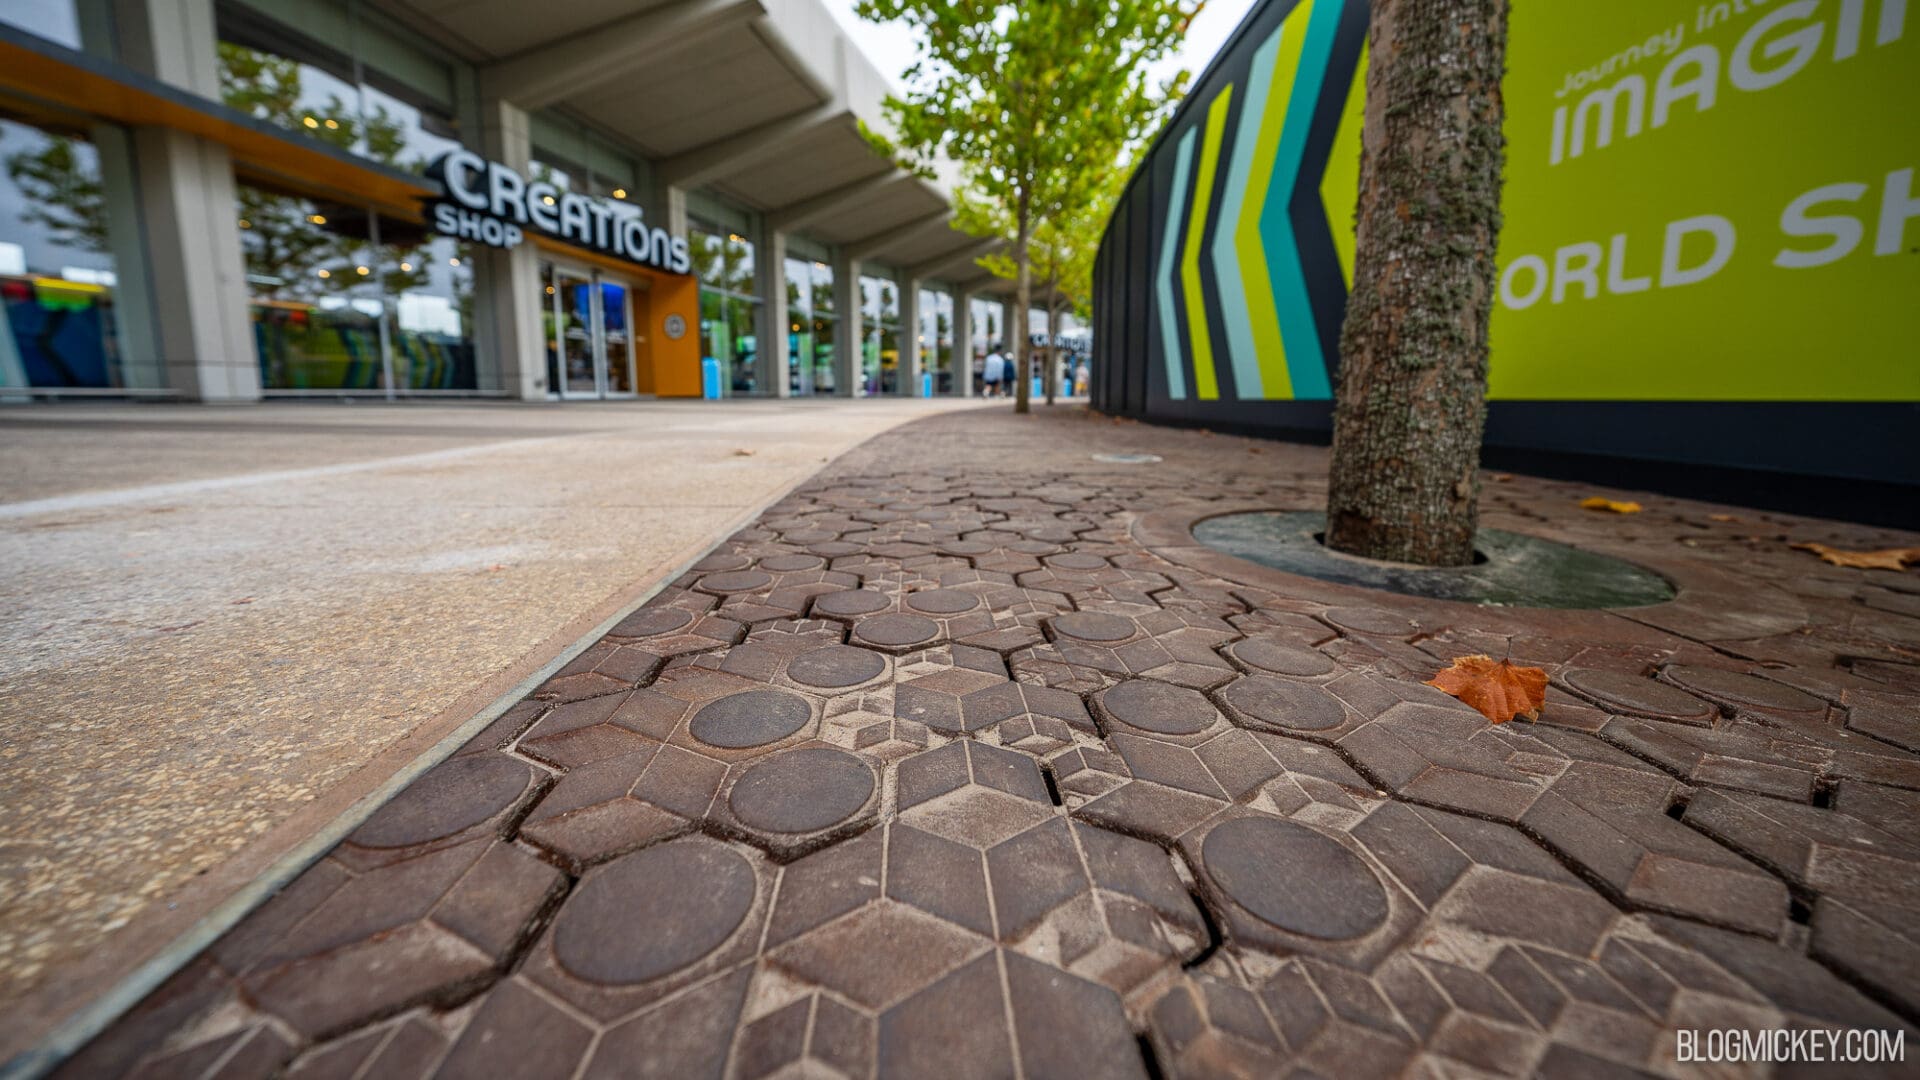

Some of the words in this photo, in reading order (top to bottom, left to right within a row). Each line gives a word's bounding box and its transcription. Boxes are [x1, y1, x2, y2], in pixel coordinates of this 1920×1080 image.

[1554, 23, 1684, 98] Journey
[1696, 0, 1769, 33] in
[434, 203, 524, 248] SHOP
[444, 150, 691, 275] CREATIONS
[1500, 214, 1738, 311] ORLD
